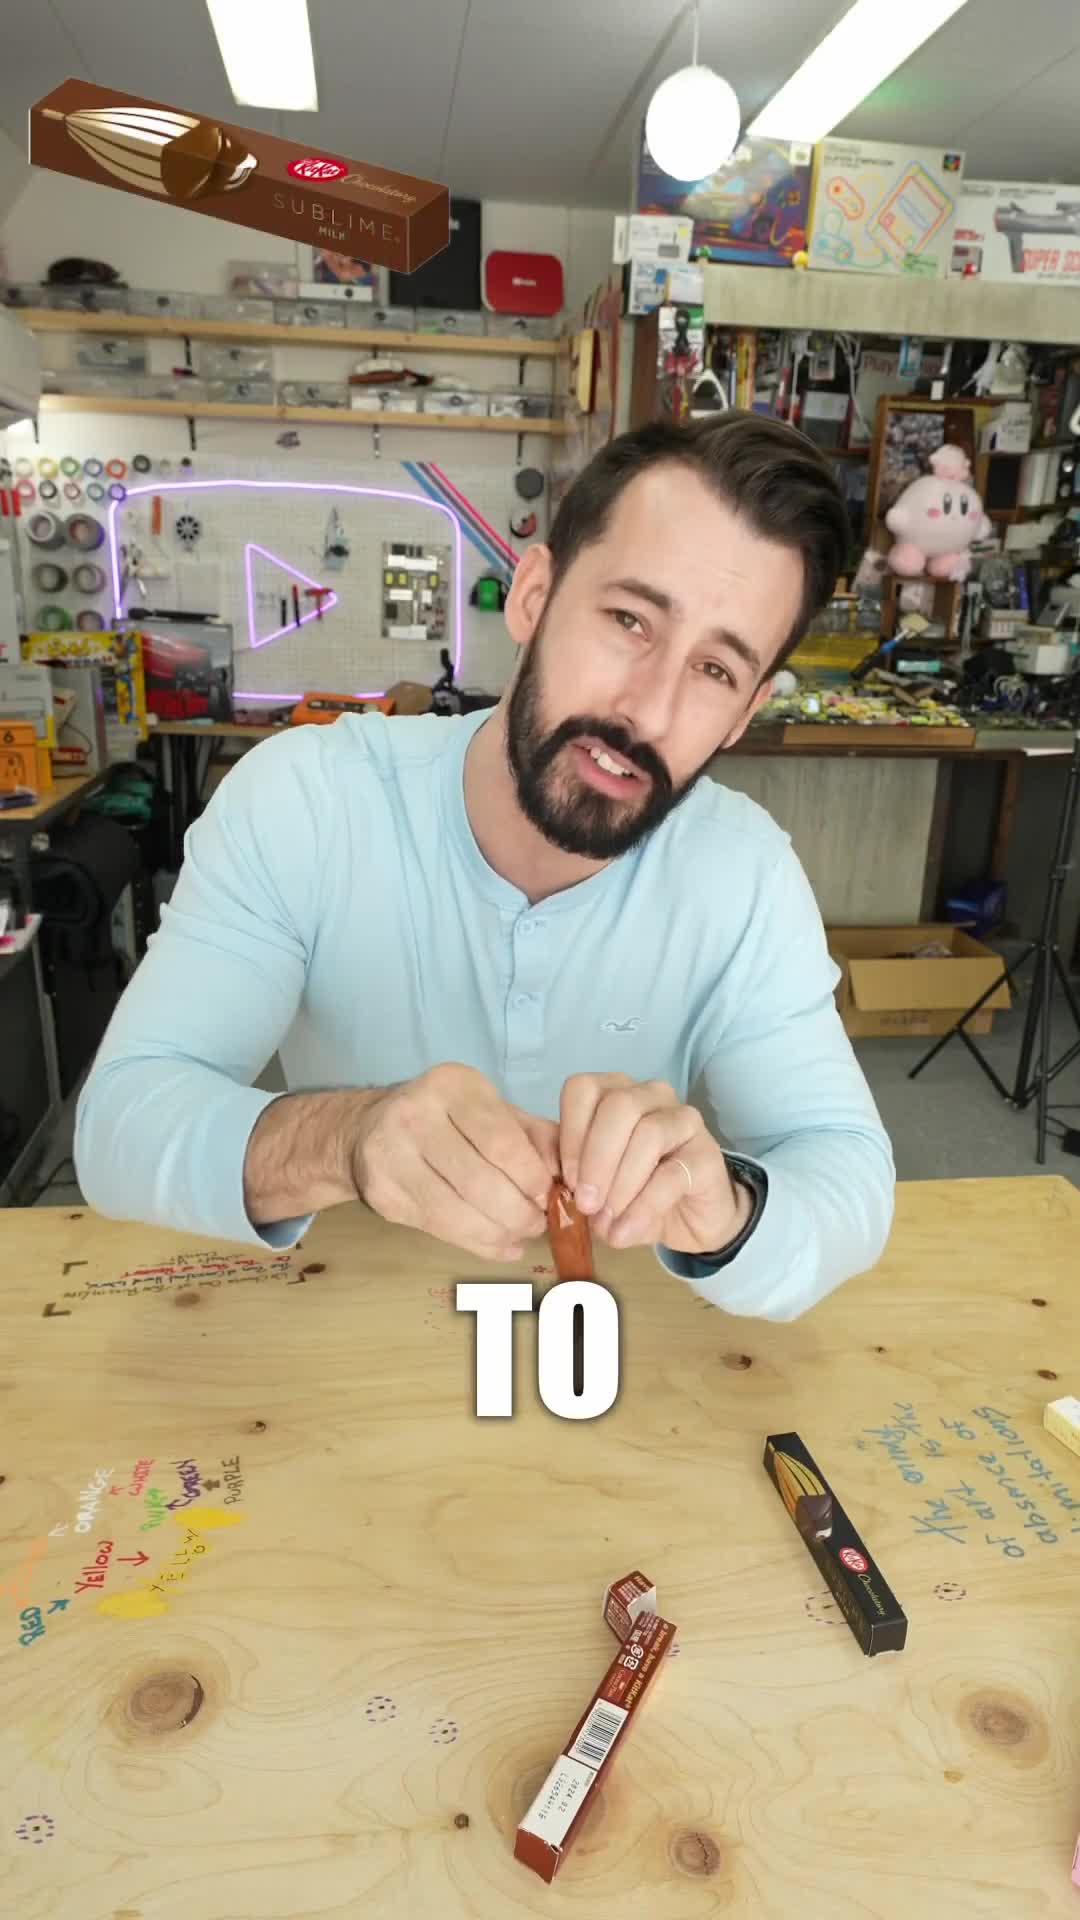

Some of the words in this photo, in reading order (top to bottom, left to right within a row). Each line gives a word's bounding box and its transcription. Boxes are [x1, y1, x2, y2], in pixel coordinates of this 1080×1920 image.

[223, 1455, 245, 1505] PURPLE
[945, 1480, 996, 1520] art
[19, 1606, 46, 1646] RED
